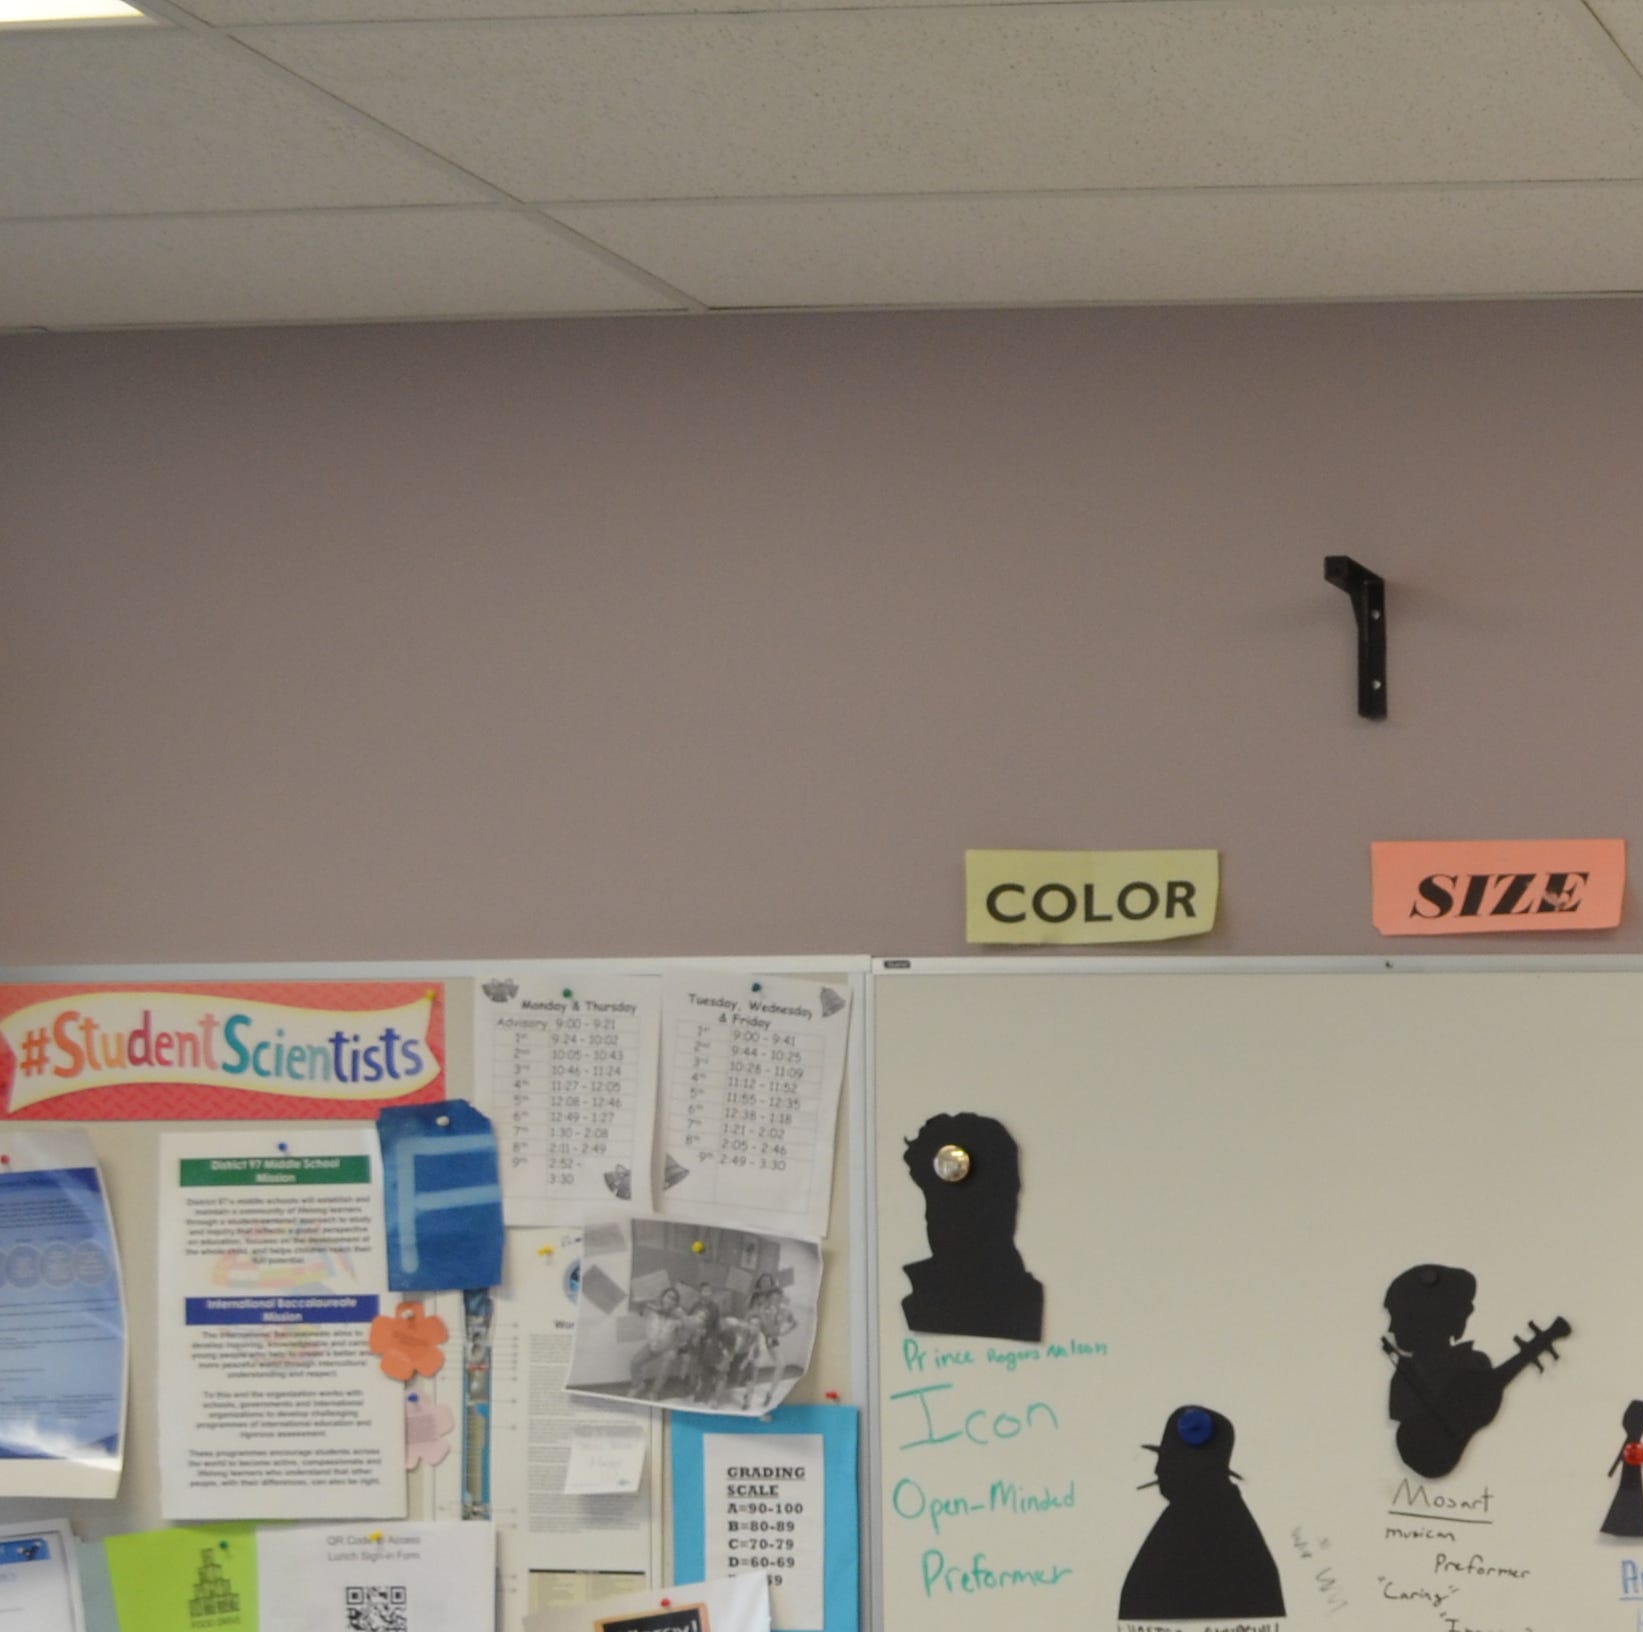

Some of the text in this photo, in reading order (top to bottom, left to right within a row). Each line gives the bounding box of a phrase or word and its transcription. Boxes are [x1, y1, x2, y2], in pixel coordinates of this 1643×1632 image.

[984, 878, 1199, 927] COLOR
[1408, 872, 1590, 920] SIZE
[521, 1000, 639, 1016] Monday & Thursday
[749, 1001, 814, 1021] Wednesday
[496, 1018, 549, 1031] Advisory
[731, 1013, 772, 1031] Friday
[18, 1008, 426, 1084] #StudentScientists
[303, 1158, 341, 1168] School
[255, 1173, 296, 1183] Mission
[206, 1299, 276, 1310] International
[262, 1312, 303, 1323] Mission
[889, 1382, 1060, 1451] Icon
[726, 1466, 807, 1480] GRADING
[726, 1484, 780, 1498] SCALE
[727, 1502, 804, 1515] A=90-100
[727, 1520, 796, 1533] B=80-89
[727, 1538, 795, 1551] C=70-79
[727, 1556, 796, 1569] D=60-69
